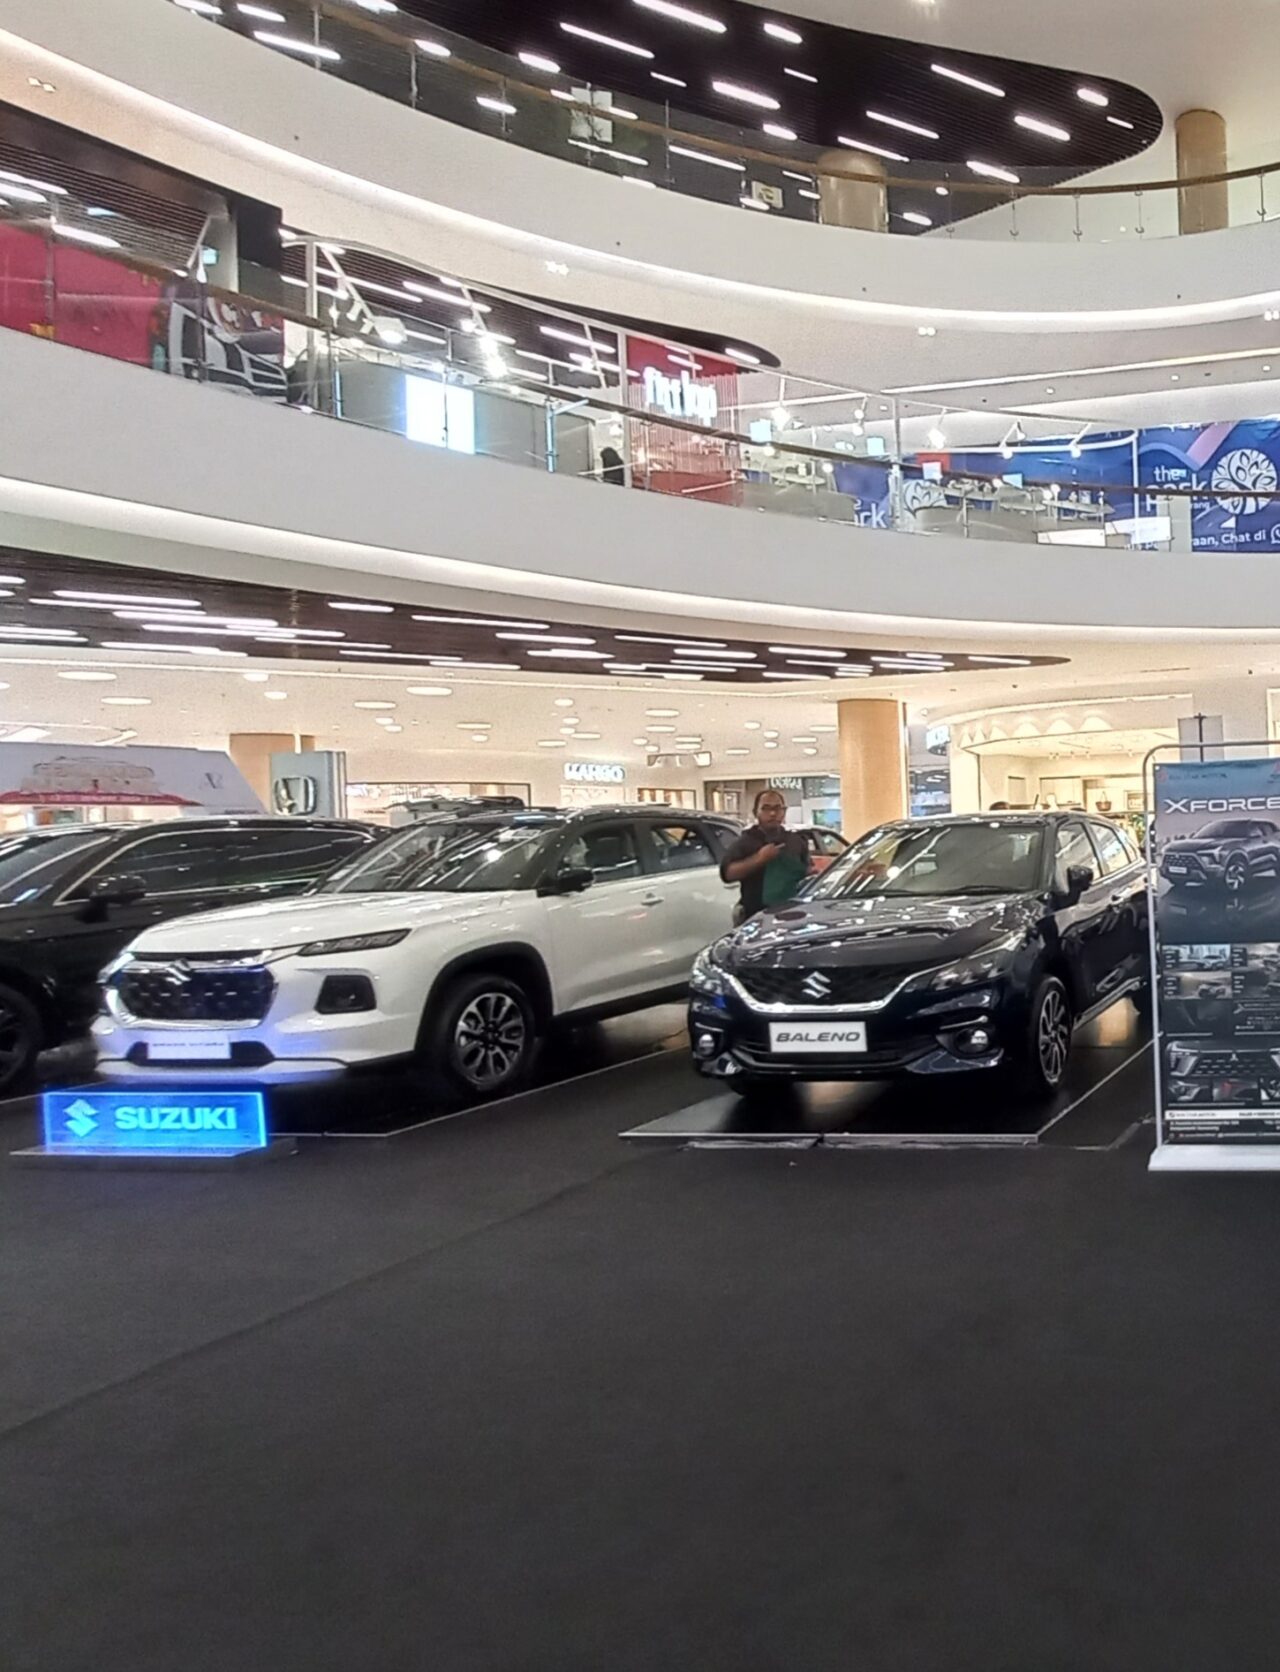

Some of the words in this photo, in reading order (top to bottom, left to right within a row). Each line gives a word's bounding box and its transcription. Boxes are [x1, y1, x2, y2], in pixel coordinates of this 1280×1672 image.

[1154, 465, 1180, 482] the
[1221, 532, 1251, 544] Chat
[1254, 530, 1266, 541] di
[775, 1031, 861, 1043] BALENO
[115, 1106, 237, 1130] SUZUKI
